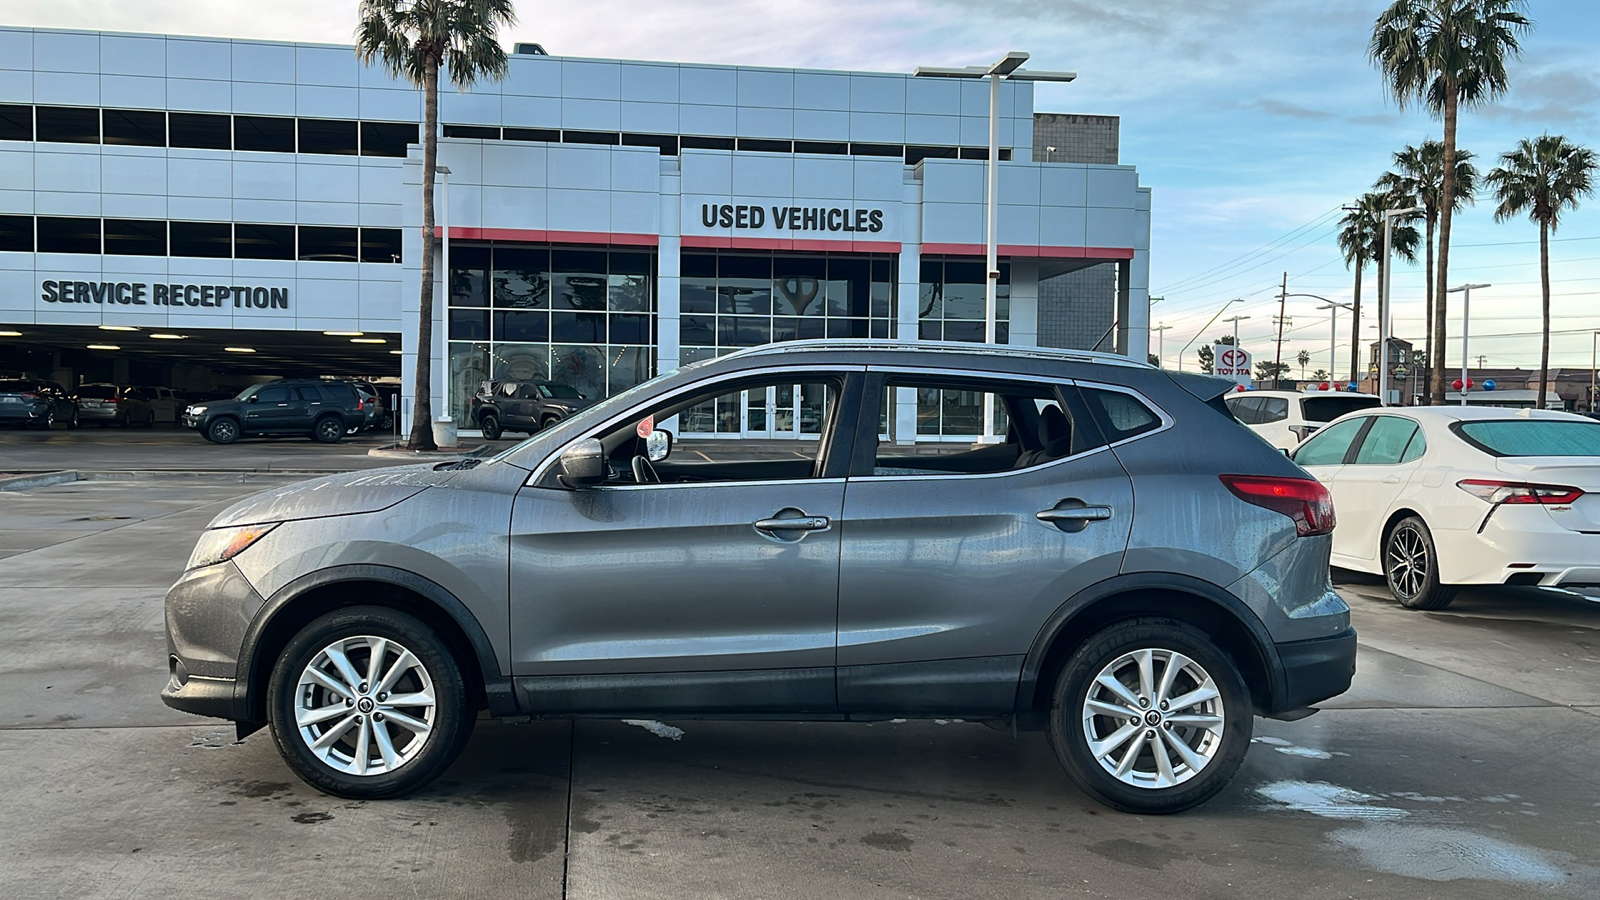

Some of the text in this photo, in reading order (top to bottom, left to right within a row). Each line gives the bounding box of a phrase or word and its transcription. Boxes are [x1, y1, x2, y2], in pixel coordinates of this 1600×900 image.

[702, 203, 884, 233] USED VEHICLES
[41, 280, 288, 309] SERVICE RECEPTION
